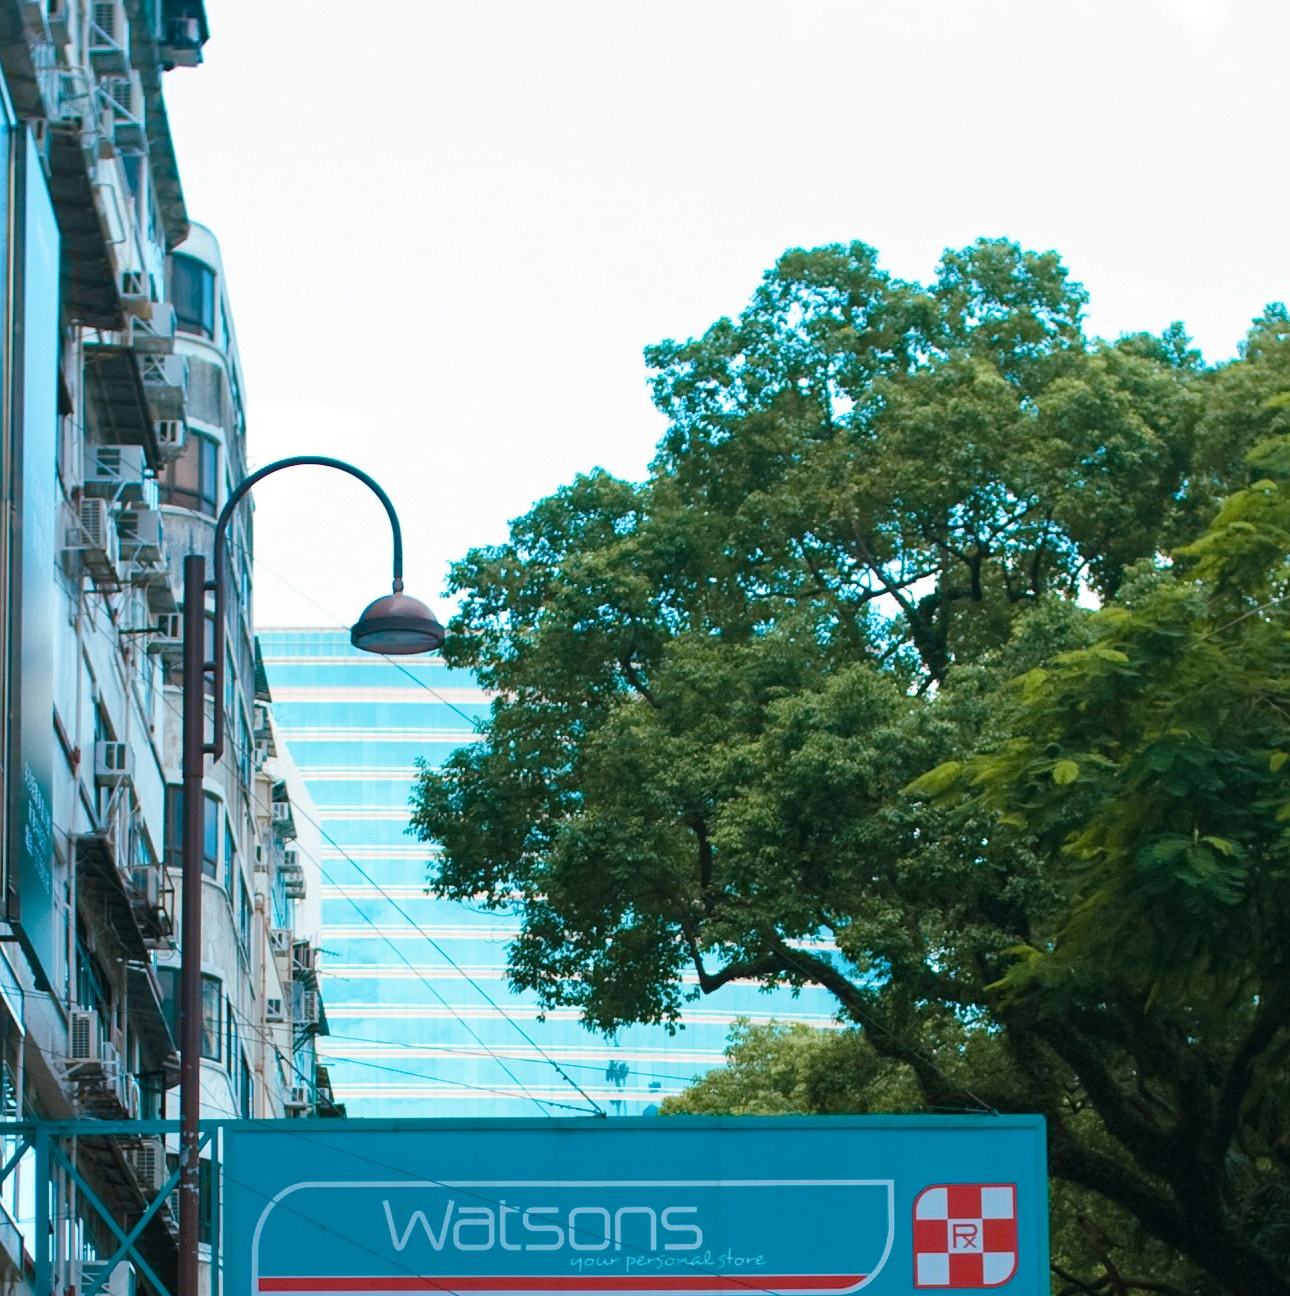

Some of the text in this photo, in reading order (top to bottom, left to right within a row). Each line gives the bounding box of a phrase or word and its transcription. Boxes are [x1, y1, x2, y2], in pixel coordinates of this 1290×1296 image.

[382, 1199, 703, 1252] Watsons
[570, 1247, 767, 1273] your personal store
